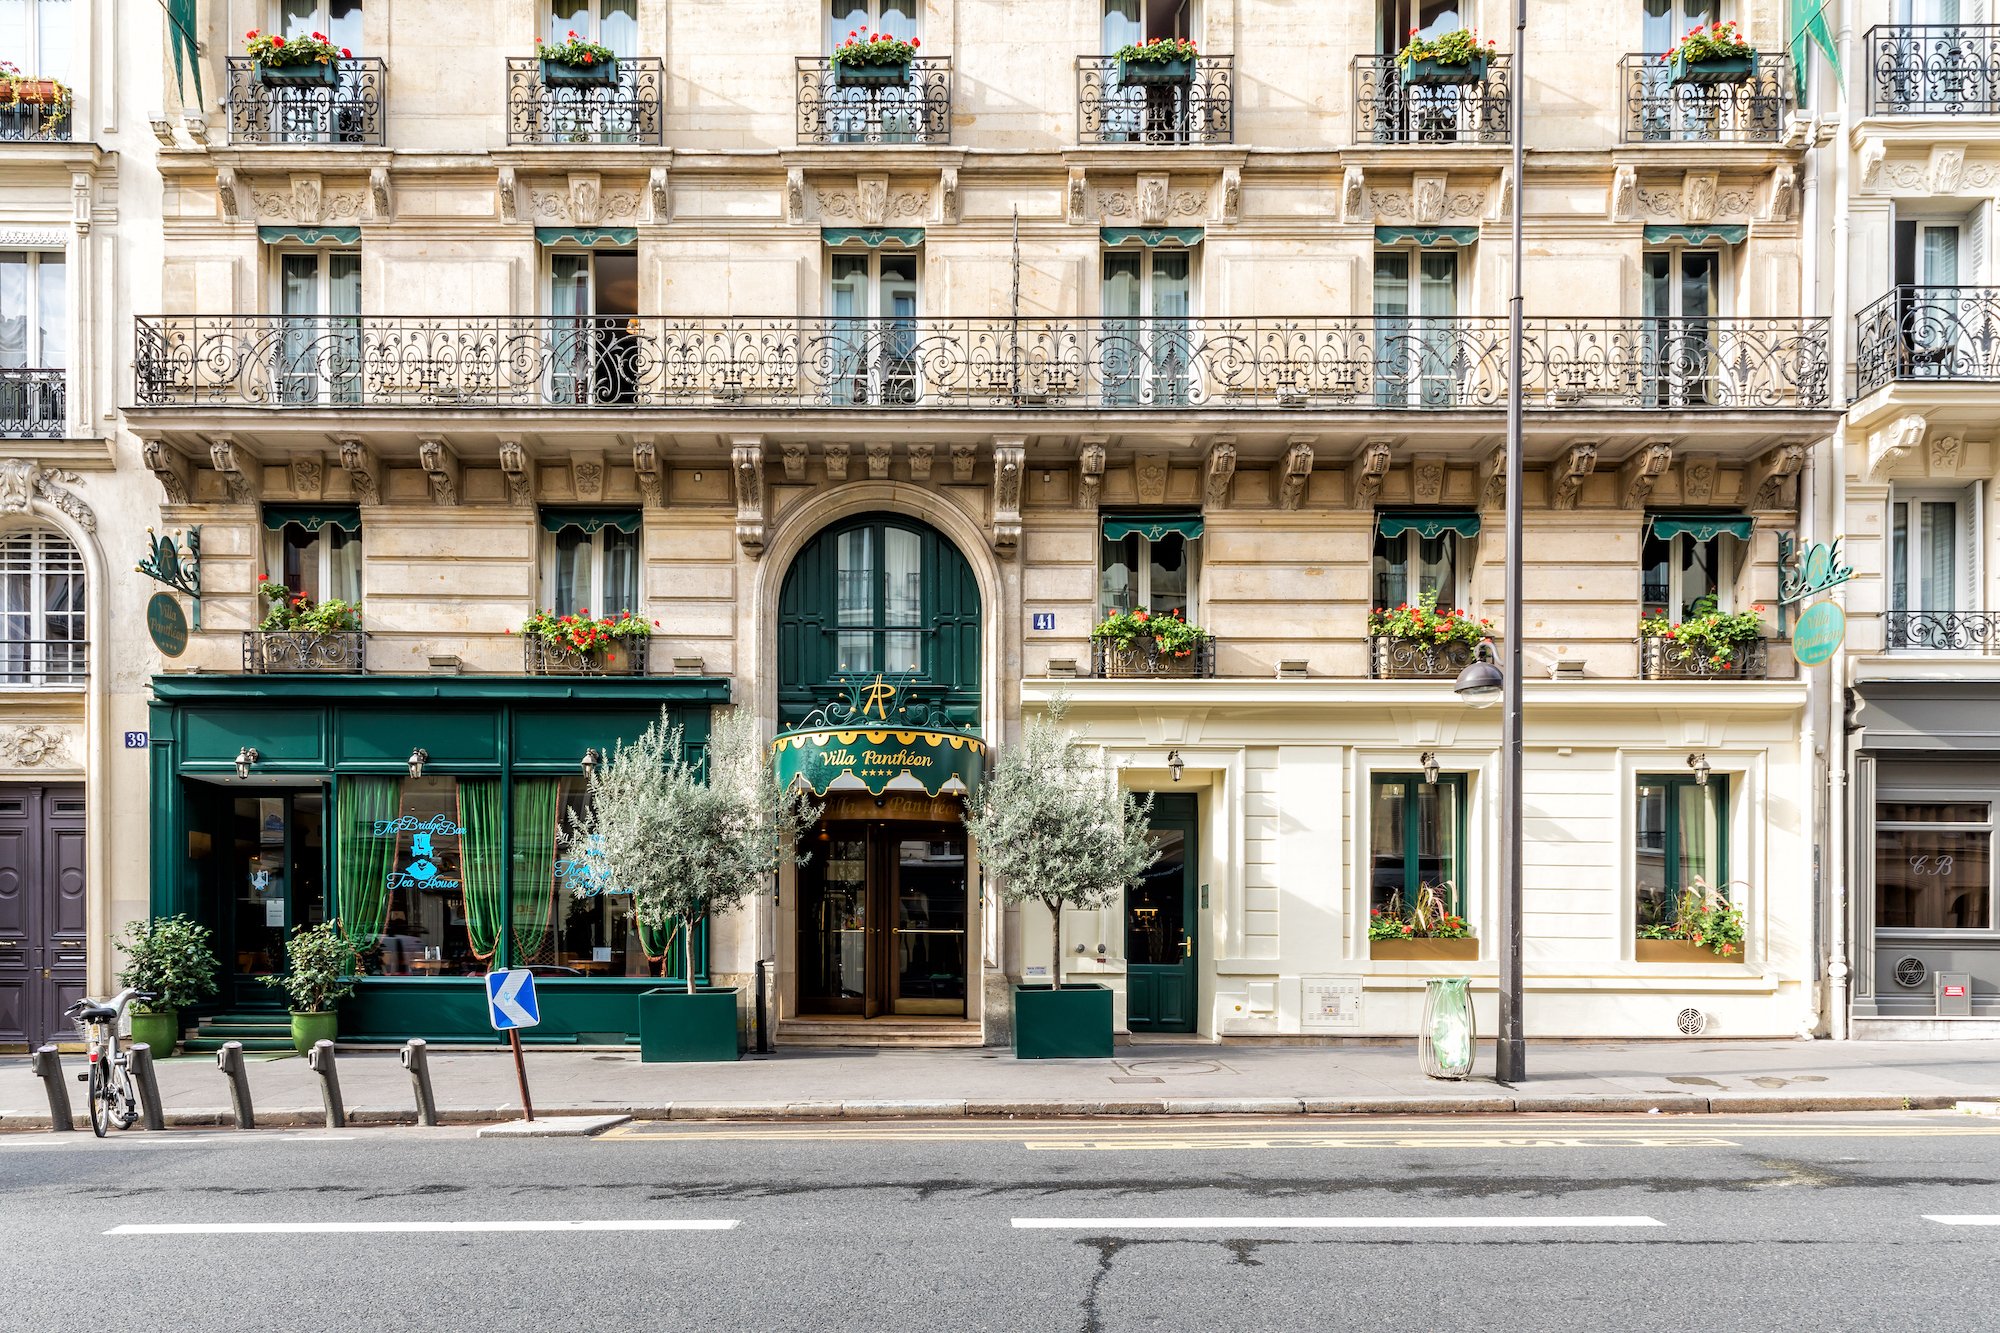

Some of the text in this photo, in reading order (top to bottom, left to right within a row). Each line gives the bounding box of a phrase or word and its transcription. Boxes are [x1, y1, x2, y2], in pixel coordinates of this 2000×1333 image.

[158, 602, 177, 621] Villa
[1037, 614, 1052, 629] 41
[127, 733, 146, 747] 39
[819, 748, 933, 767] Villa Panthéon
[374, 814, 467, 836] The Bridge Bar
[386, 872, 459, 890] Tea House
[1030, 1138, 1734, 1149] LIVRAISON
